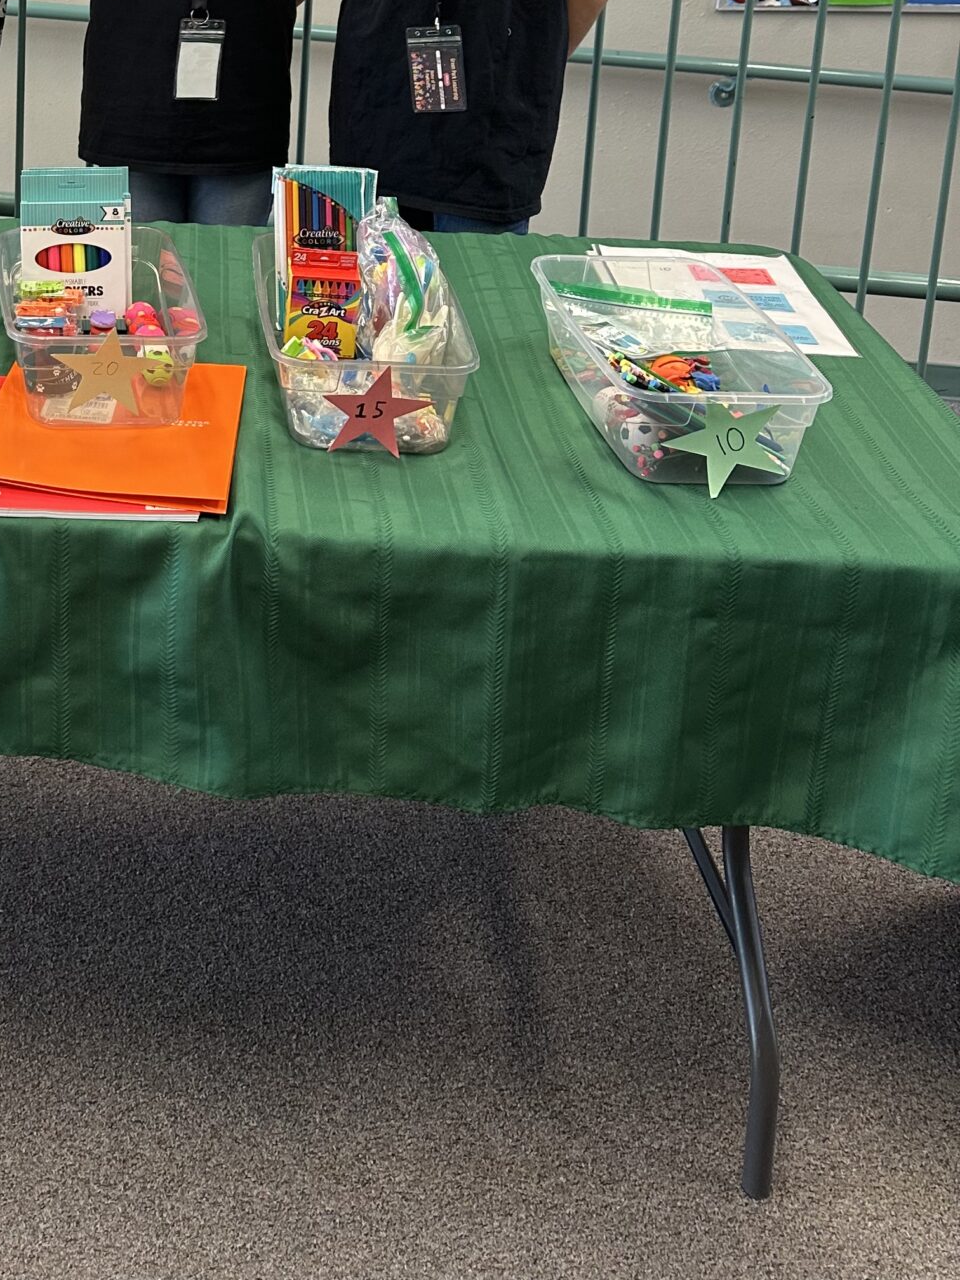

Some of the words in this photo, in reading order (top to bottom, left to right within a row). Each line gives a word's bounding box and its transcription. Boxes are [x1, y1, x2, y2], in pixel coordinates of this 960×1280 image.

[112, 207, 119, 216] 8
[56, 219, 90, 228] Creative
[299, 228, 340, 238] Creative
[301, 237, 340, 246] COLORS
[293, 252, 307, 262] 24
[306, 320, 339, 339] 24
[92, 361, 119, 376] 20
[354, 400, 388, 419] 15
[716, 427, 745, 456] 10
